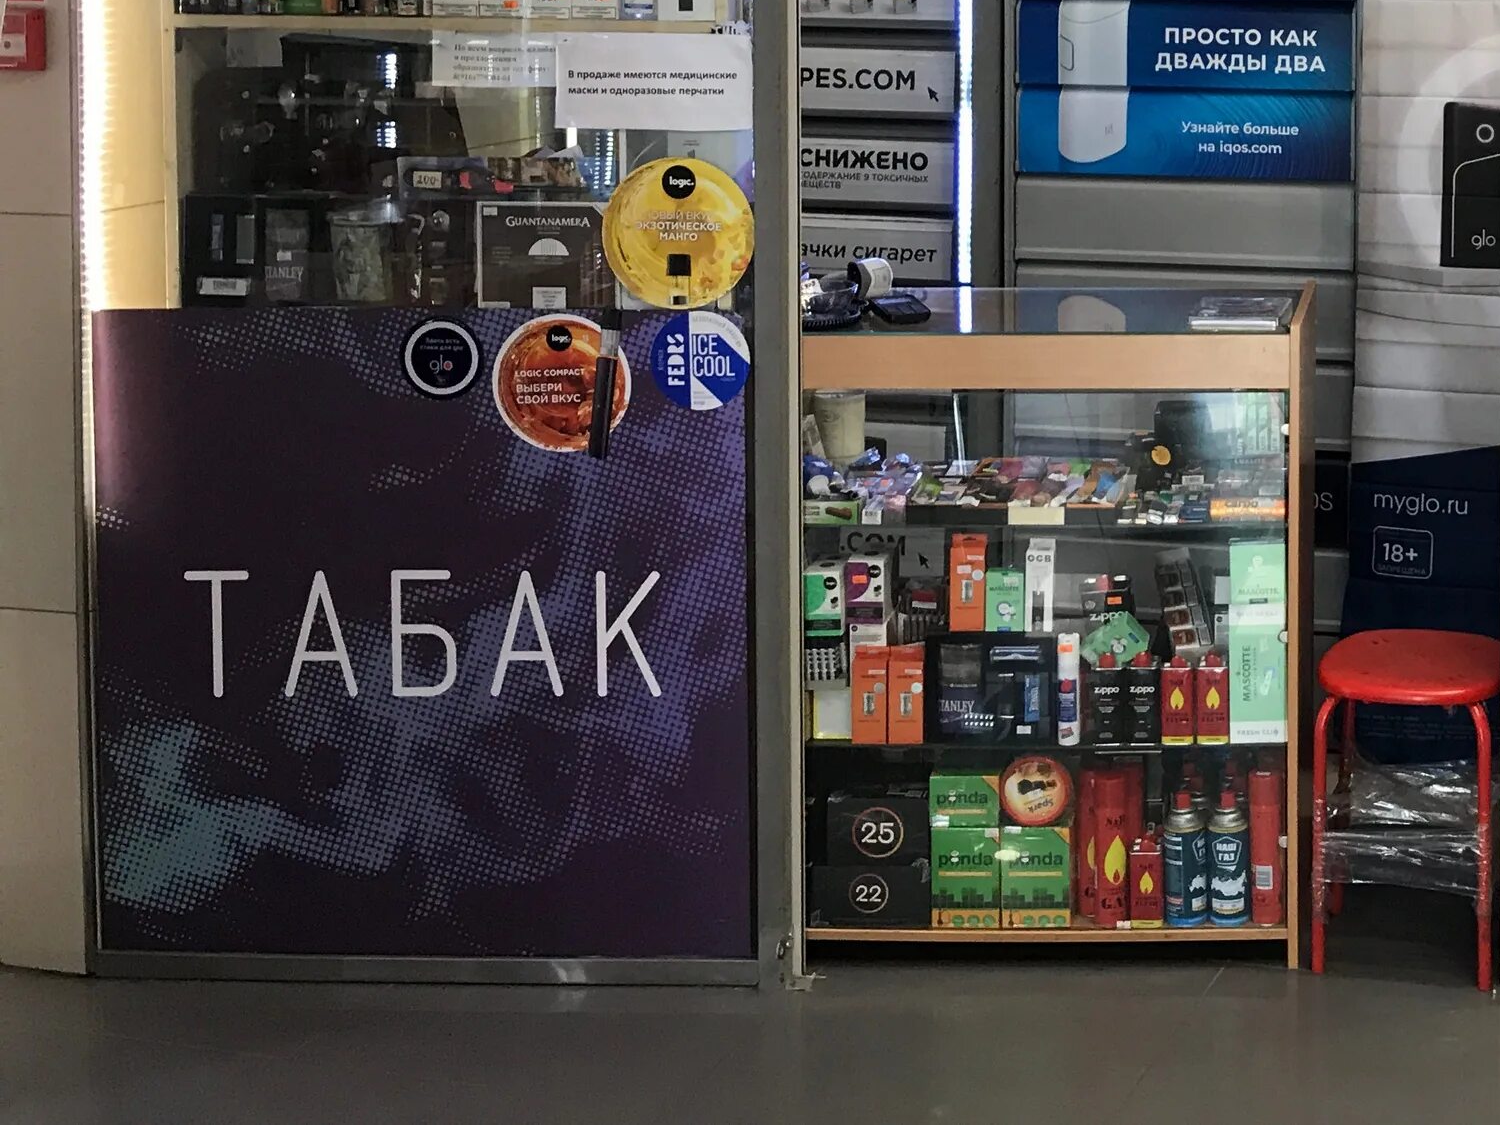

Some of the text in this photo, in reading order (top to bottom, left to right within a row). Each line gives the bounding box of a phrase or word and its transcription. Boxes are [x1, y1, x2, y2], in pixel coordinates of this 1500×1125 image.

[1164, 27, 1318, 47] ПРОСТО КАК
[1155, 52, 1326, 74] ДВАЖДЫ ДВА
[568, 70, 737, 82] В продаже имеются медицинские
[801, 67, 916, 91] PES.COM
[568, 86, 724, 97] маски и одноразовые перчатки
[1181, 121, 1299, 136] Узнайте больше
[1198, 140, 1282, 156] на iqos.com
[801, 147, 929, 172] СНИЖЕНО
[801, 179, 842, 190] ЕЩЕСТВ
[863, 173, 870, 181] 9
[872, 174, 929, 183] ТОКСИЧНЫХ
[505, 214, 591, 229] GUANTANAMERA
[651, 208, 684, 220] ОВЫЙ
[636, 220, 722, 232] ЭКЗОТИЧЕСКОЕ
[659, 232, 698, 242] МАНГО
[1471, 229, 1496, 250] glo
[852, 245, 937, 263] сигарет
[692, 334, 719, 355] ICE
[430, 354, 454, 375] glo
[514, 367, 586, 378] LOGIC COMPACT
[693, 355, 736, 377] COOL
[516, 382, 563, 393] ВЫБЕРИ
[516, 393, 581, 405] СВОЙ ВКУС
[1374, 492, 1468, 516] myglo.ru
[1027, 554, 1052, 563] OCB
[1382, 542, 1419, 563] 18+
[184, 570, 661, 697] ТАБАК
[1242, 644, 1252, 703] MASCOTTE
[861, 822, 895, 844] 25
[1216, 843, 1238, 852] НАШ
[1217, 852, 1236, 861] ГАЗ
[855, 884, 882, 902] 22
